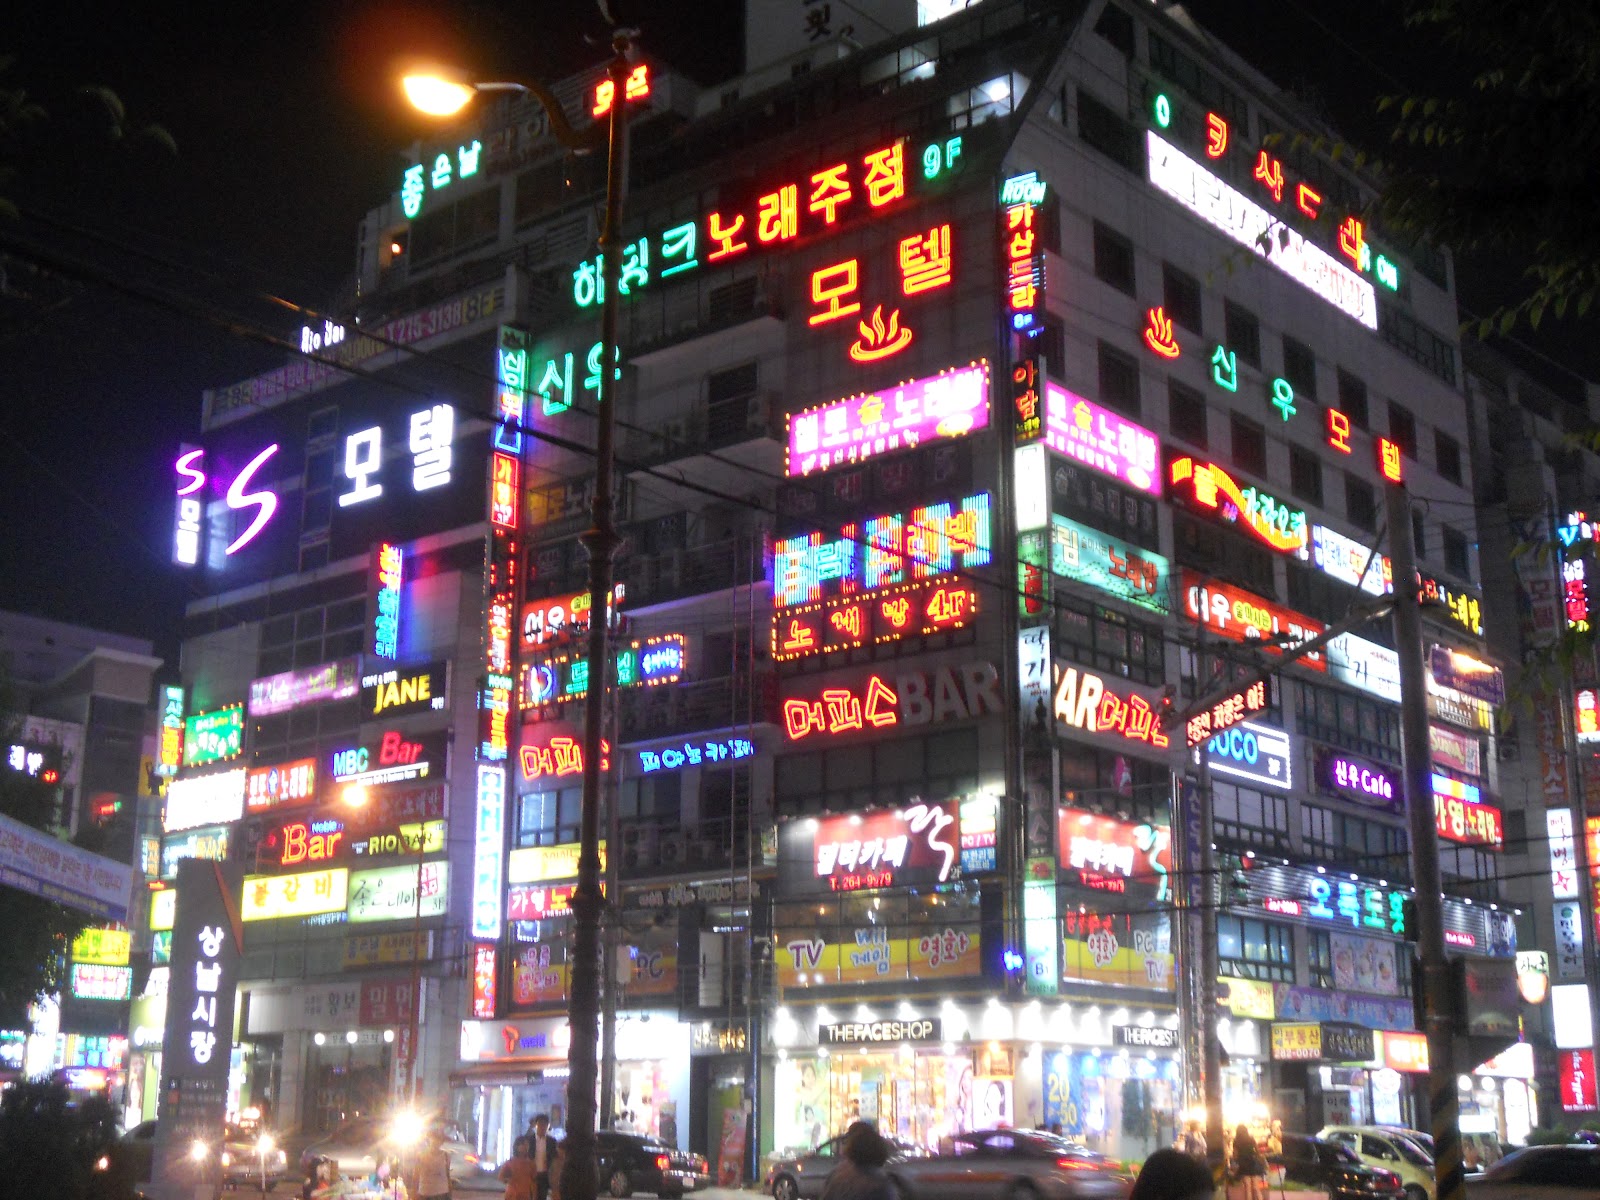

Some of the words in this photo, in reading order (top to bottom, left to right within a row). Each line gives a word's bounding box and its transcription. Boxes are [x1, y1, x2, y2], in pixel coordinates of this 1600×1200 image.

[709, 143, 905, 261] 노래주점
[924, 137, 963, 180] 9F
[1002, 180, 1047, 204] ROOM
[809, 224, 952, 326] 모텔
[893, 368, 984, 429] 노래방
[1211, 345, 1297, 421] 신우
[1326, 408, 1402, 481] 모텔
[339, 403, 455, 508] 모텔
[1100, 413, 1156, 473] 노래방
[225, 443, 279, 556] S
[1108, 545, 1159, 595] 노래방
[784, 598, 910, 651] 노래방
[927, 590, 967, 621] 4F
[1188, 586, 1232, 629] 여우
[373, 674, 431, 714] JANE
[896, 663, 998, 726] BAR
[1053, 662, 1104, 733] AR
[333, 747, 369, 777] MBC
[379, 731, 423, 766] Bar
[520, 737, 609, 782] 머피
[281, 823, 343, 865] Bar
[368, 835, 397, 855] RIO
[1466, 806, 1496, 845] 노래방
[817, 835, 907, 876] 멀티카페
[787, 940, 825, 970] TV
[851, 944, 889, 975] 게임
[919, 929, 969, 969] 영화
[1087, 929, 1118, 967] 영화
[1135, 931, 1154, 954] PC
[636, 952, 663, 979] PC
[1145, 960, 1165, 981] TV
[190, 925, 225, 1065] 상남시장
[1285, 1029, 1321, 1046] 부동산
